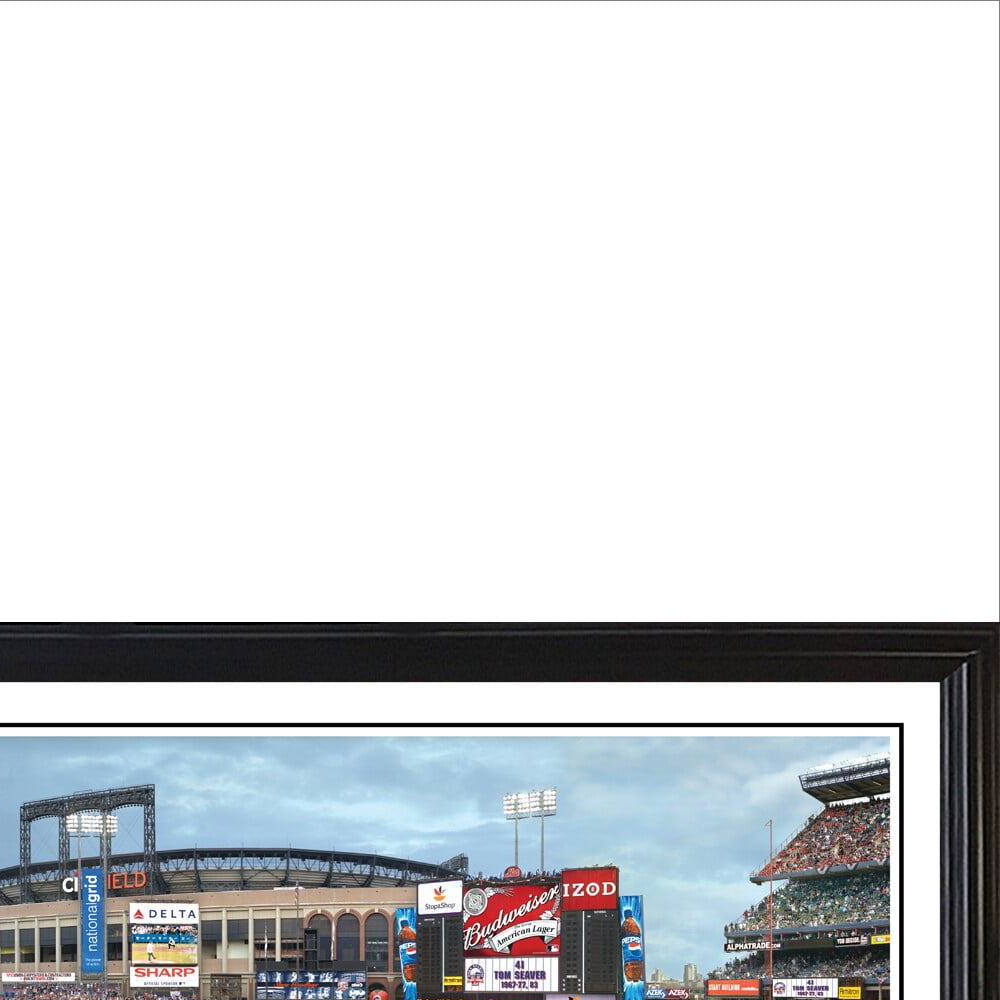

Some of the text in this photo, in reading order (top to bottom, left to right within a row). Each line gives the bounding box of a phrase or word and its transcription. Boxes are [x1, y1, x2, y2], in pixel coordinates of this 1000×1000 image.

[107, 871, 147, 889] IELD
[563, 882, 616, 897] IZOD
[84, 875, 100, 952] nationalgrid
[149, 909, 196, 919] DELTA
[463, 884, 560, 950] Budweiser
[497, 925, 555, 947] American Lager
[515, 960, 524, 970] 41
[134, 967, 195, 977] SHARP
[494, 971, 511, 980] TOM
[514, 971, 546, 980] SEAVER
[501, 981, 538, 989] 1967-77, 83
